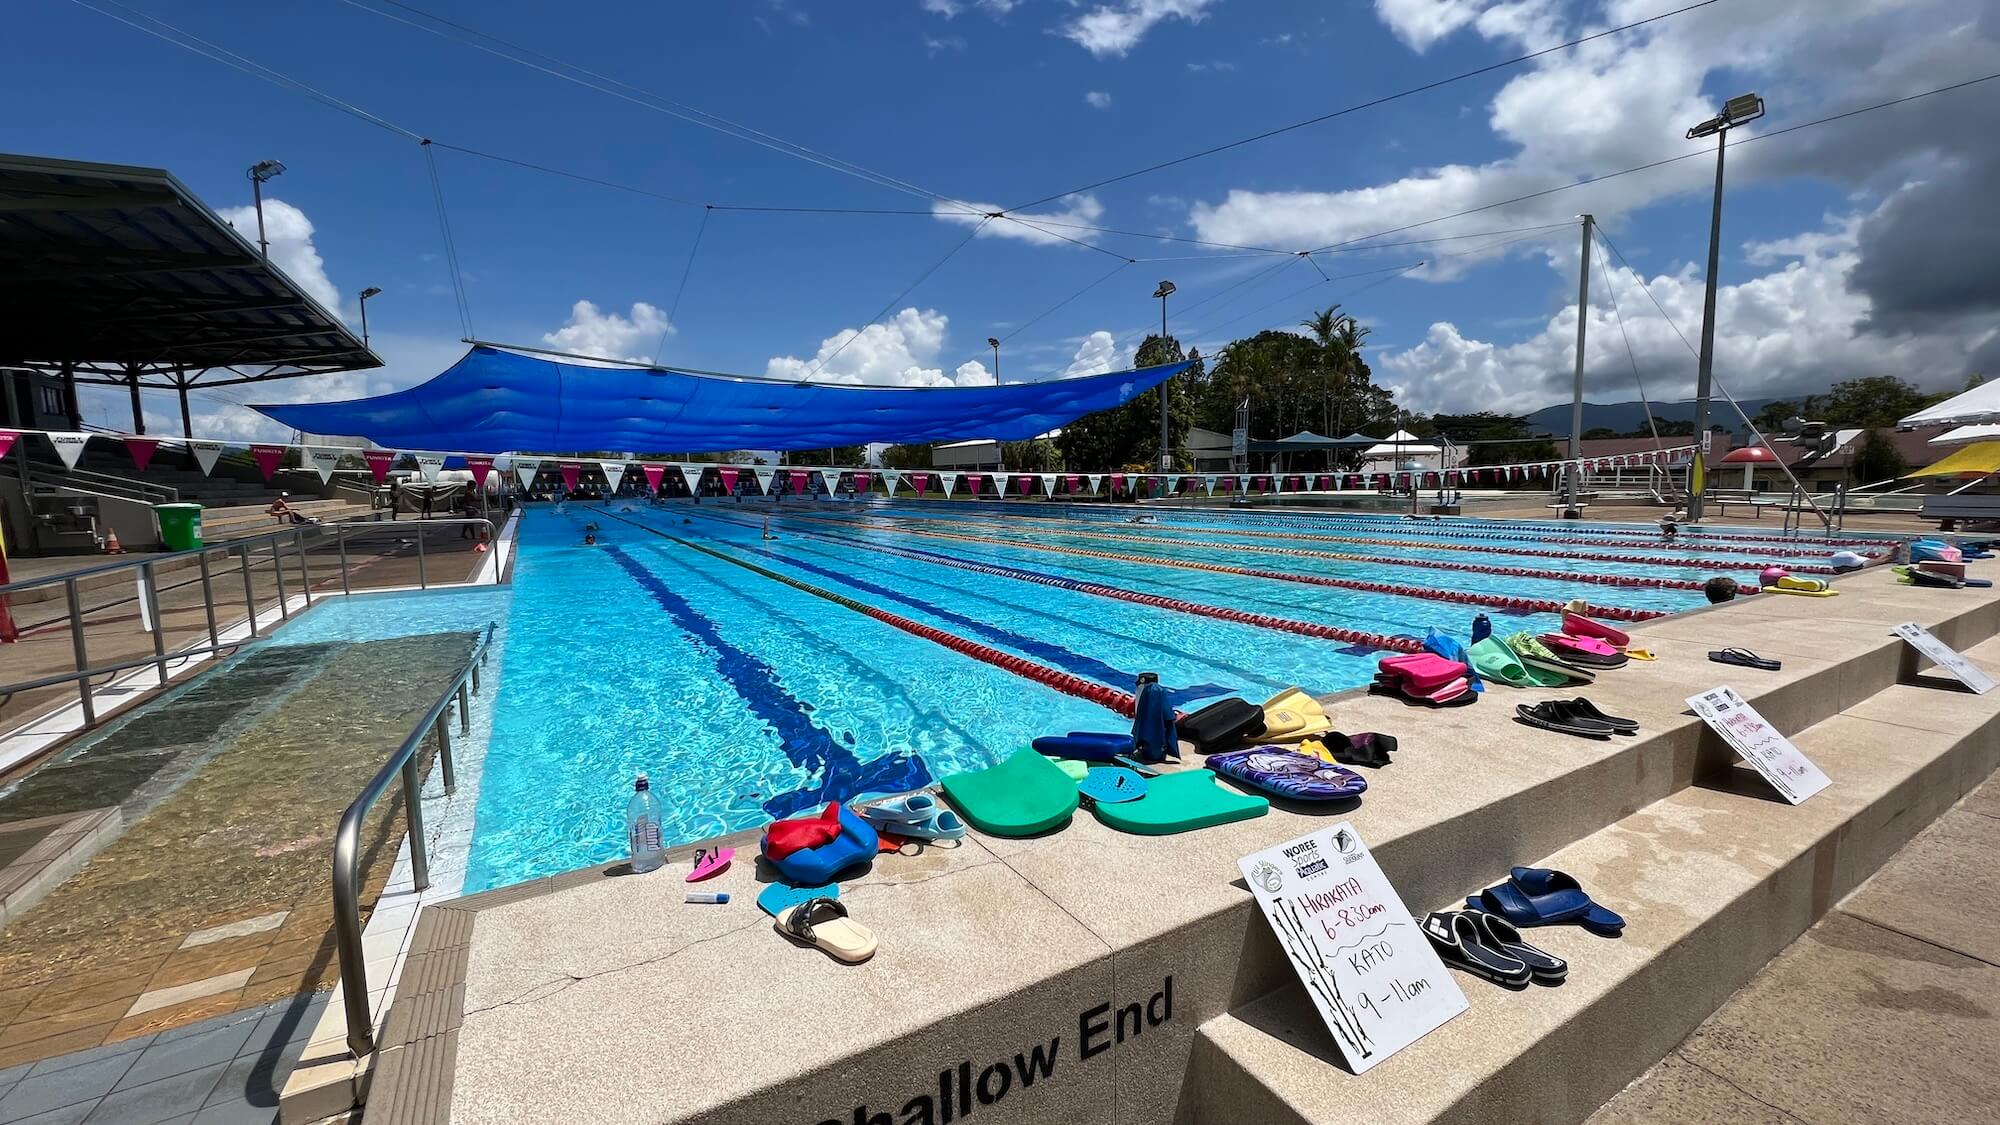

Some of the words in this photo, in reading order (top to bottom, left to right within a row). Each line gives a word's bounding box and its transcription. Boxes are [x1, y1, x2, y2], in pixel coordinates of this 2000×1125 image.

[1282, 839, 1318, 859] WOREE
[1292, 850, 1320, 868] Sports
[1297, 877, 1363, 918] HIRAKATA
[1348, 940, 1393, 976] KATO
[1079, 975, 1174, 1061] End
